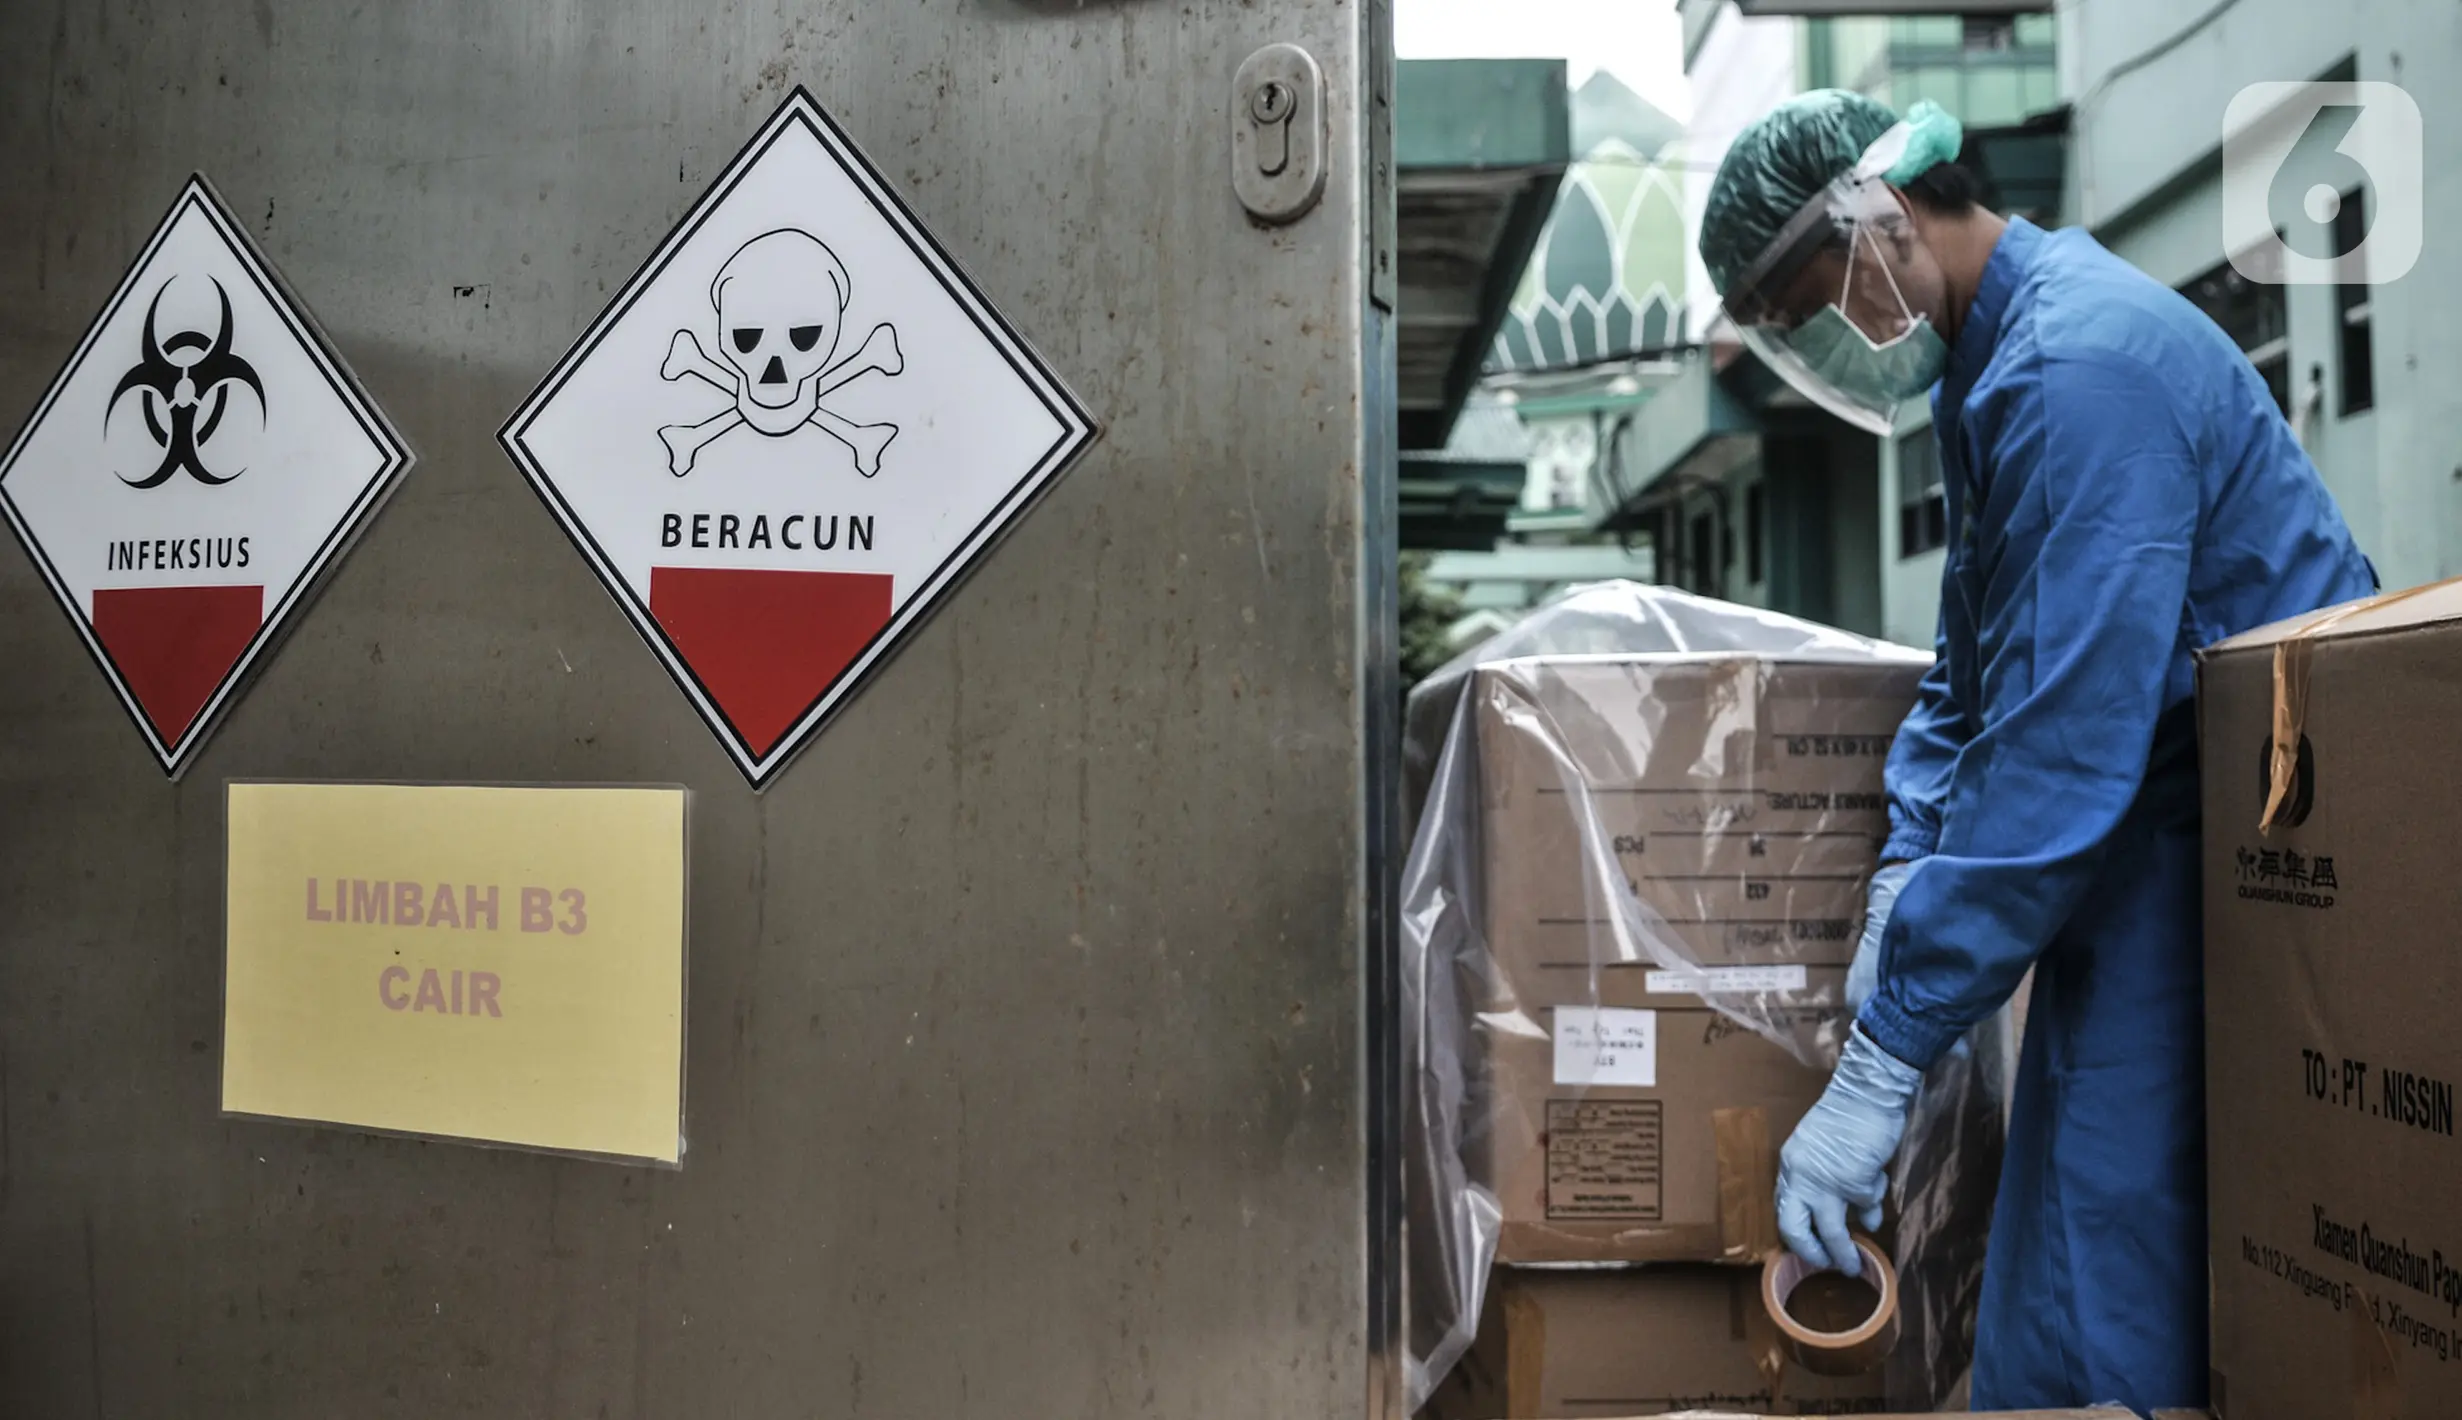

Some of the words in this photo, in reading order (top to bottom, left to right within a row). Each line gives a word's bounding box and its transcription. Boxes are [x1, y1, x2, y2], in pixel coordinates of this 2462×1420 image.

[107, 536, 253, 571] INFEKSIUS
[661, 512, 877, 552] BERACUN
[306, 877, 500, 932] LIMBAH
[520, 888, 588, 936] B3
[2238, 884, 2294, 905] QUANSHUN
[2295, 892, 2334, 909] GROUP
[378, 965, 504, 1019] CAIR
[2383, 1067, 2453, 1137] NISSIN
[2312, 1203, 2358, 1264] Xiamen
[2360, 1220, 2430, 1295] Quanshun
[2432, 1248, 2462, 1319] Pap
[2283, 1252, 2342, 1312] Xinguang
[2387, 1299, 2448, 1362] Xinyang
